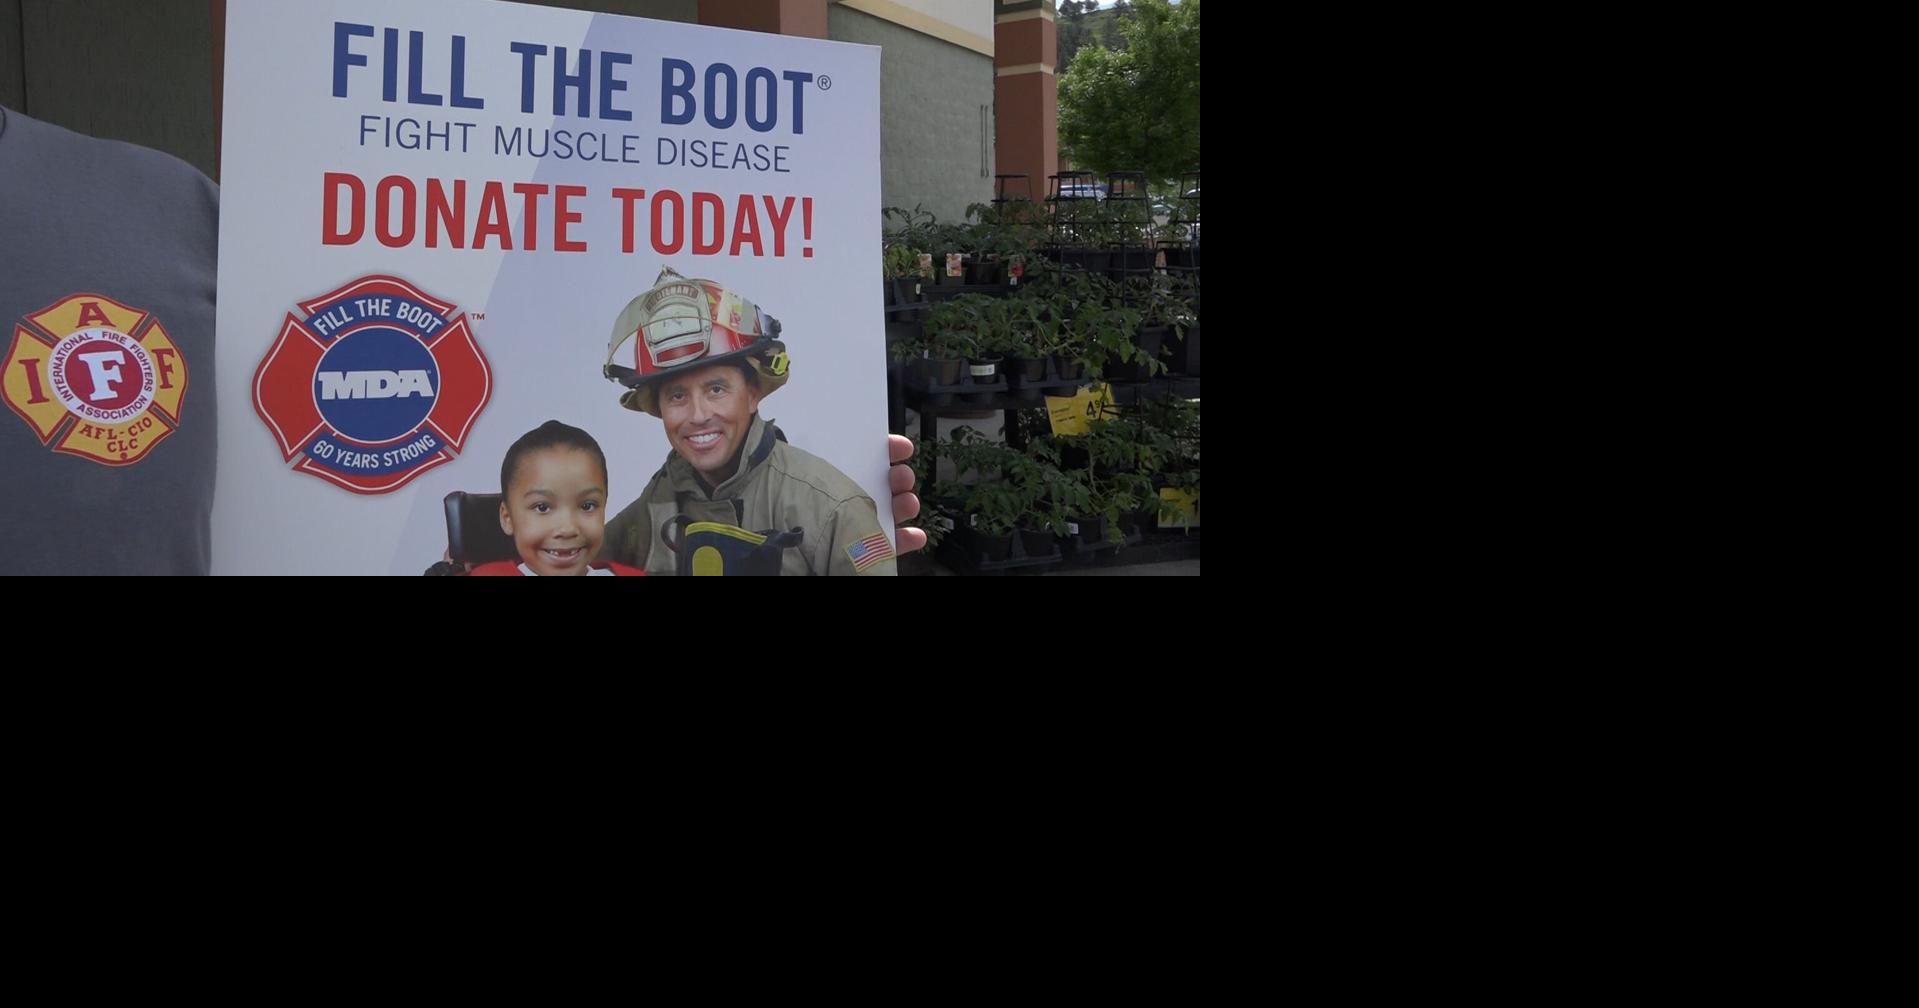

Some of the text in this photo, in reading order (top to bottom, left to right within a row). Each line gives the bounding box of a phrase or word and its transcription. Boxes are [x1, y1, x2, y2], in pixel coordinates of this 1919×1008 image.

[332, 21, 484, 110] FILL
[510, 41, 633, 122] THE
[359, 115, 791, 173] FIGHT MUSCLE DISEASE
[321, 172, 815, 258] DONATE TODAY!
[76, 302, 117, 328] A
[313, 298, 442, 336] FILL THE BOOT
[471, 313, 485, 321] TM
[18, 358, 50, 404] I
[52, 331, 153, 402] INTERNATIONAL FIRE FIGHTERS
[78, 350, 126, 401] F
[152, 348, 175, 389] F
[318, 369, 434, 400] MDA
[76, 395, 148, 420] ASSOCIATION
[106, 438, 138, 453] CLC
[312, 434, 436, 469] 60 YEARS STRONG
